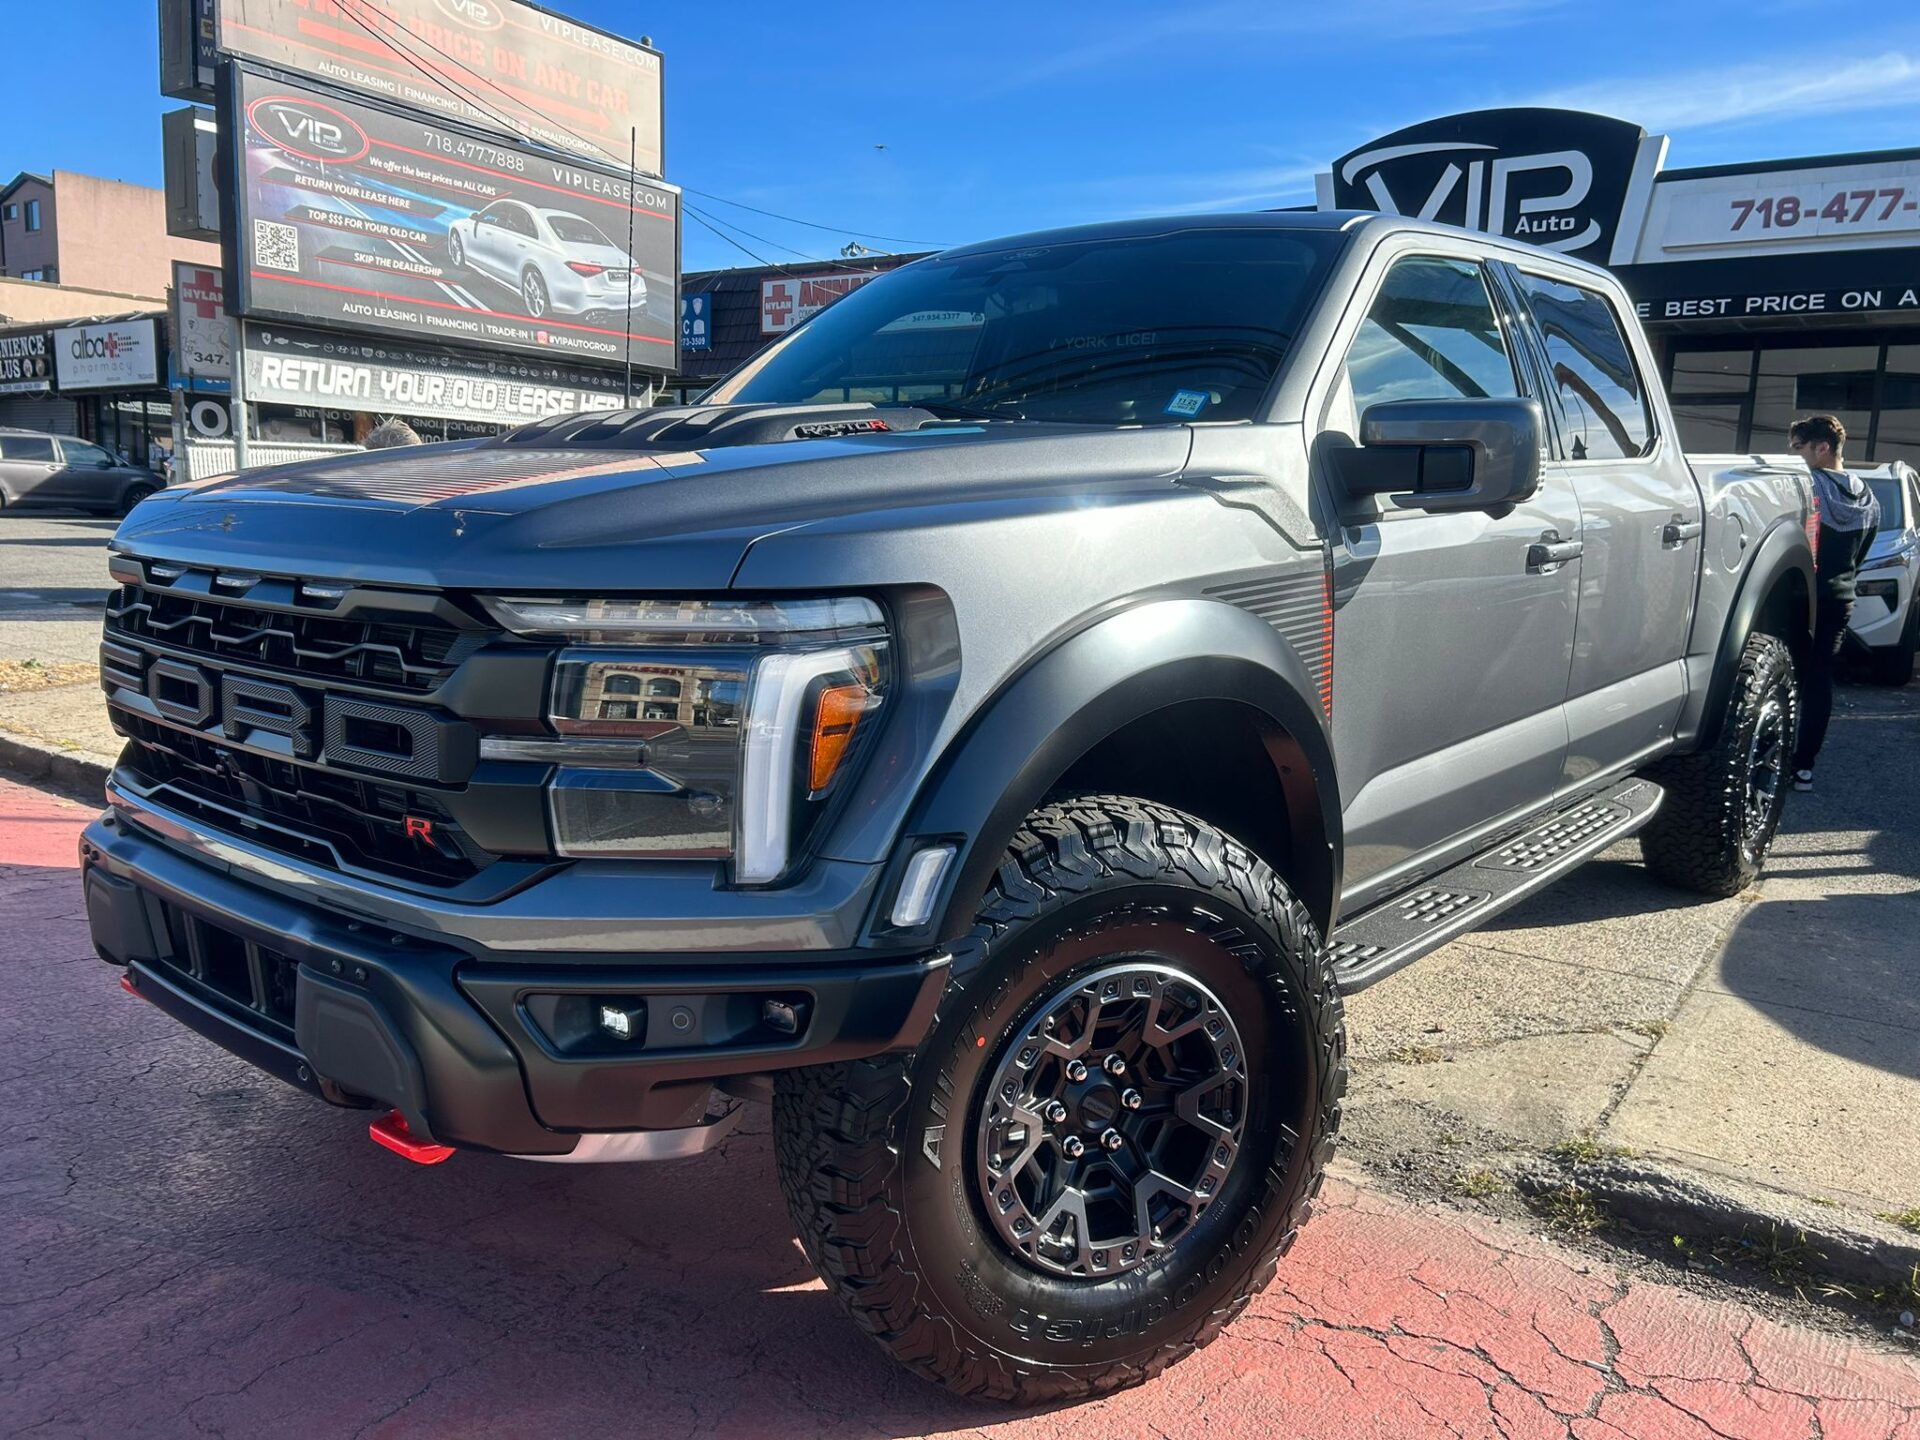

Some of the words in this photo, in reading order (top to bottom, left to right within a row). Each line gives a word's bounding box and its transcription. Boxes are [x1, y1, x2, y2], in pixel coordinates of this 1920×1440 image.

[540, 15, 657, 70] VIPLEASE.COM
[408, 16, 487, 66] PRICE
[493, 46, 527, 80] ON
[534, 59, 581, 98] ANY
[587, 79, 629, 114] CAR
[318, 61, 349, 78] AUTO
[350, 70, 395, 92] LEASING
[404, 86, 458, 111] FINANCING
[278, 112, 342, 144] VIP
[423, 131, 525, 171] 718.477.7888
[295, 174, 333, 193] RETURN
[334, 182, 361, 198] YOUR
[361, 189, 387, 204] LEASE
[388, 194, 411, 209] HERE
[369, 156, 382, 168] We
[383, 160, 402, 173] offer
[402, 164, 415, 175] the
[415, 168, 431, 180] best
[431, 172, 453, 186] prices
[453, 179, 463, 188] on
[463, 181, 477, 192] ALL
[477, 183, 497, 196] CARS
[552, 168, 667, 209] VIPLEASE.COM
[1365, 149, 1593, 235] VIP
[308, 210, 327, 222] TOP
[328, 211, 343, 226] $$$
[344, 215, 363, 229] FOR
[364, 219, 389, 234] YOUR
[390, 225, 408, 239] OLD
[408, 229, 427, 243] CAR
[1513, 213, 1576, 235] Auto
[1730, 187, 1920, 232] 718-477-
[354, 252, 375, 266] SKIP
[375, 256, 392, 269] THE
[392, 258, 443, 276] DEALERSHIP
[342, 302, 372, 315] AUTO
[374, 307, 417, 322] LEASING
[426, 314, 479, 333] FINANCING
[486, 324, 528, 340] TRADE-IN
[1665, 298, 1732, 317] BEST
[1745, 293, 1826, 313] PRICE
[1841, 290, 1882, 308] ON
[1897, 289, 1919, 306] A
[71, 329, 106, 360] alba
[72, 361, 133, 377] pharmacy
[260, 356, 372, 398] RETURN
[380, 369, 446, 405] YOUR
[452, 378, 498, 411] OLD
[504, 383, 575, 417] LEASE
[101, 640, 446, 783] FORD
[405, 814, 436, 849] R
